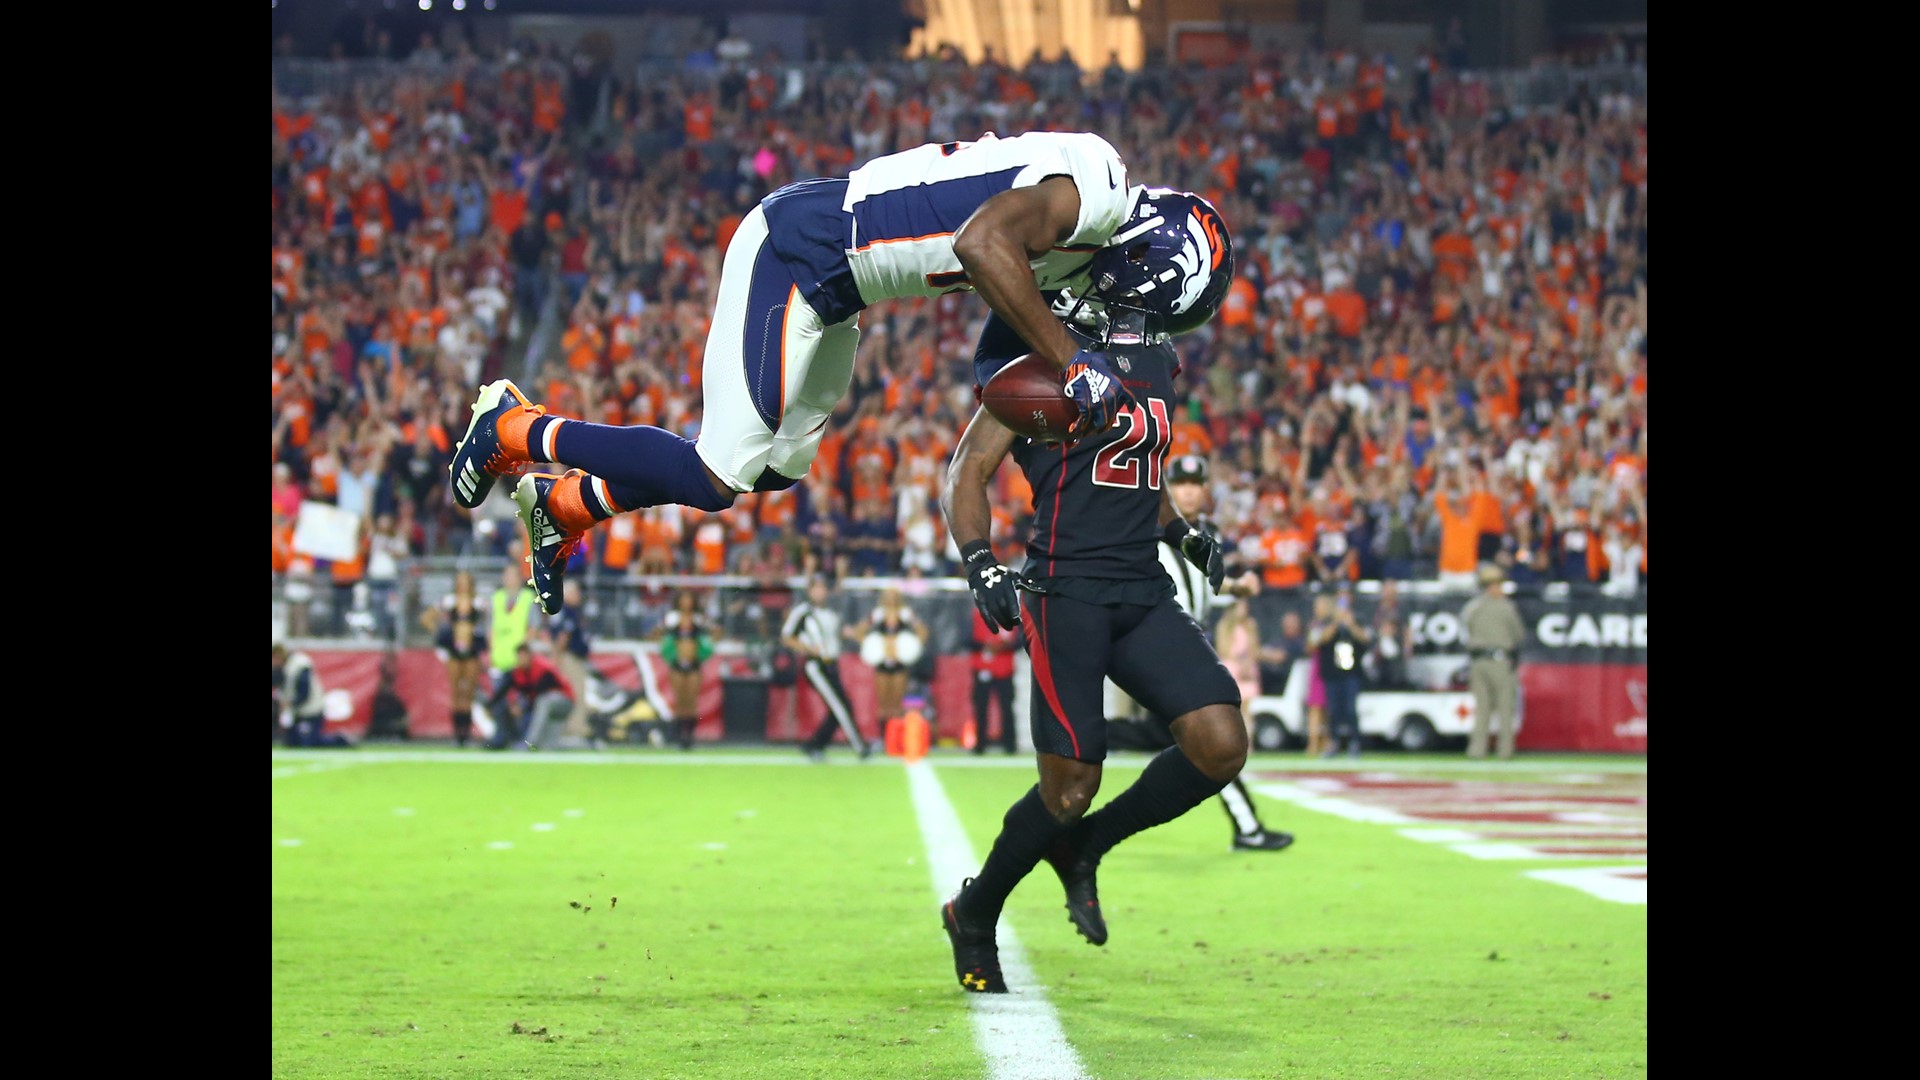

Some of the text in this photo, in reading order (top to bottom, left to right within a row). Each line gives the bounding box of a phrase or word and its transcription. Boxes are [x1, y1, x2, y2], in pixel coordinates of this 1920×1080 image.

[1083, 367, 1101, 404] adidas
[1092, 397, 1171, 491] 21
[533, 507, 543, 551] adidas
